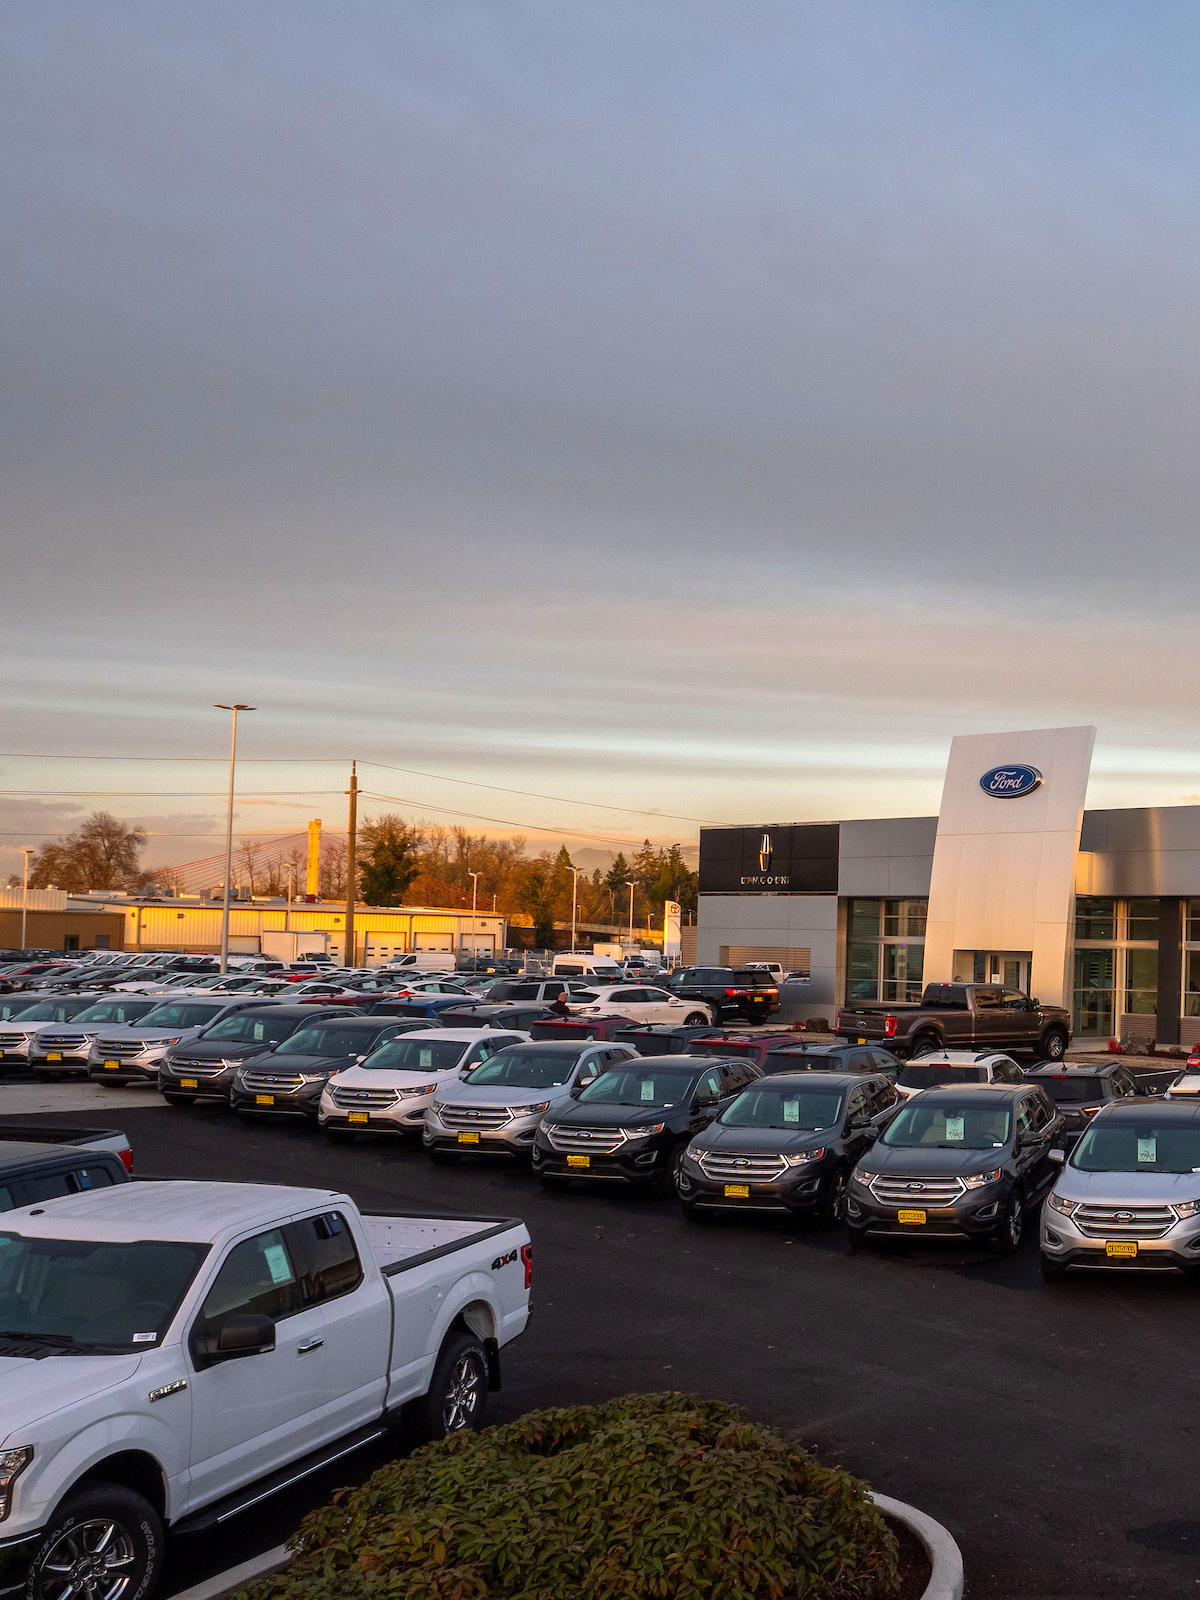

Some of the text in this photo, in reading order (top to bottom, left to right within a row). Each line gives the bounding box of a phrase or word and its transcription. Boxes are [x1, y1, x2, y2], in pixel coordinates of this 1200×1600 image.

[990, 771, 1024, 790] Ford
[725, 1185, 749, 1193] KENDALL
[900, 1212, 925, 1220] KENDALL
[1108, 1245, 1136, 1253] KENDALL
